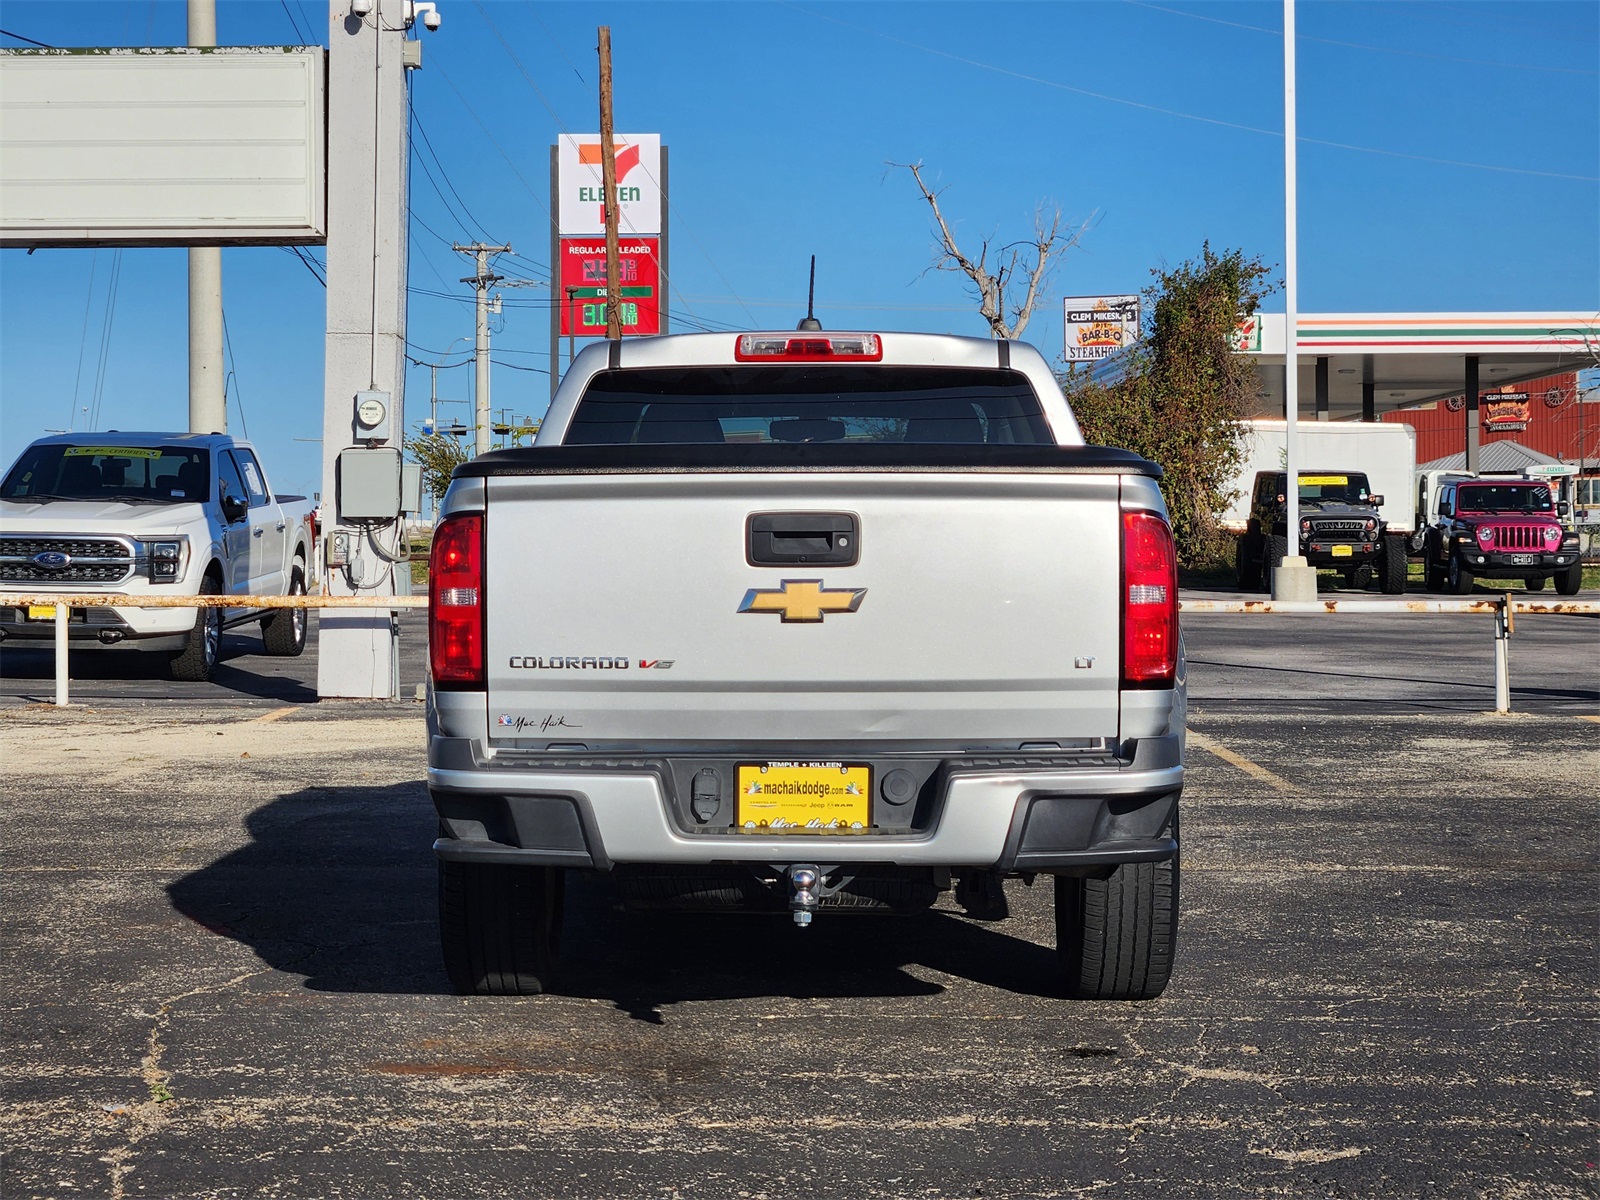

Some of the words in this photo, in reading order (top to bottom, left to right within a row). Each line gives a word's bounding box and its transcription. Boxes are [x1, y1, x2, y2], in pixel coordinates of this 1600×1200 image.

[579, 186, 640, 202] ELEEn
[569, 246, 606, 254] REGULAR
[618, 246, 651, 254] LEADED
[1071, 313, 1091, 321] CLEM
[1094, 312, 1132, 320] MIKESKS
[1082, 329, 1122, 342] BAR-B-Q
[509, 656, 629, 669] COLORADO
[638, 659, 676, 669] V6
[1074, 656, 1097, 669] LT
[513, 715, 538, 733] Mac
[763, 781, 844, 798] machaikdodge.com
